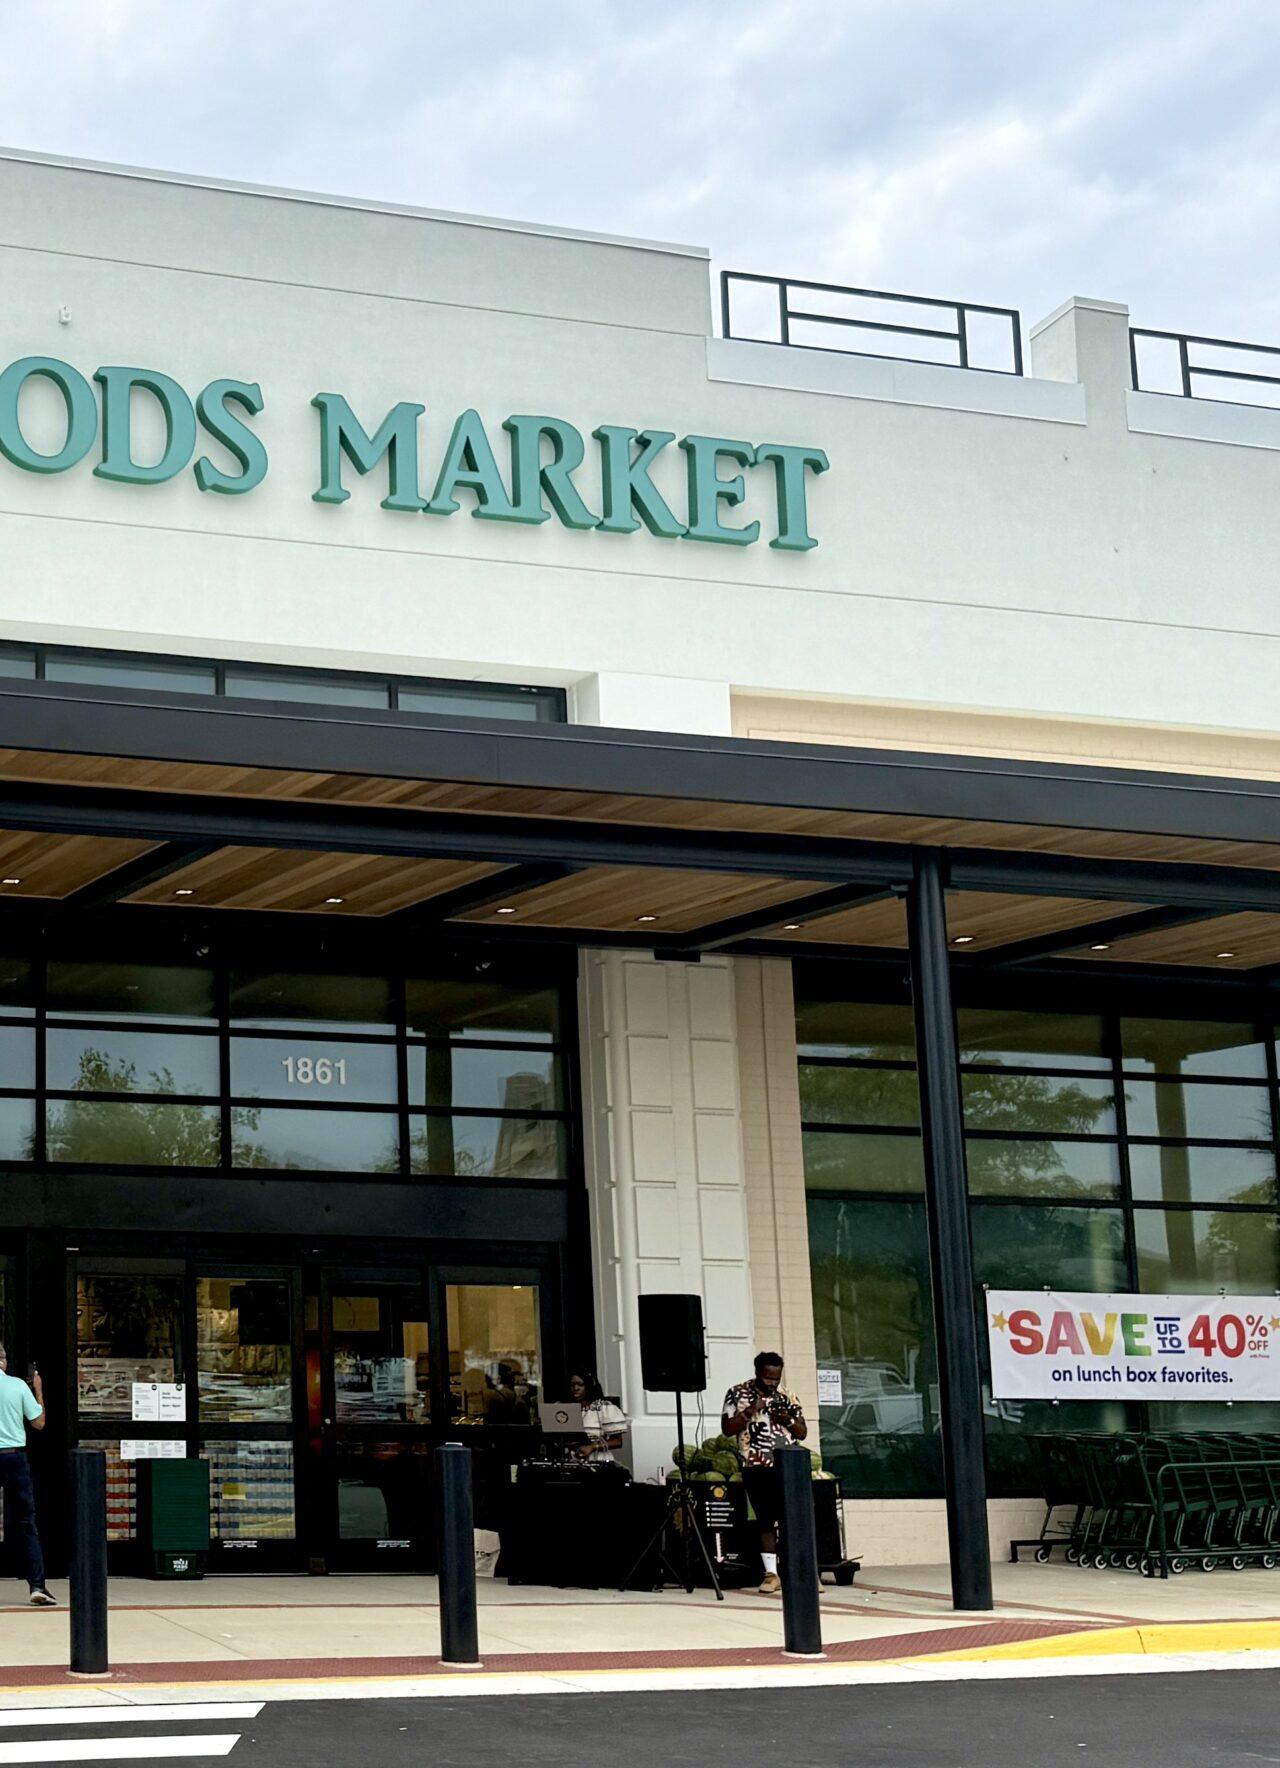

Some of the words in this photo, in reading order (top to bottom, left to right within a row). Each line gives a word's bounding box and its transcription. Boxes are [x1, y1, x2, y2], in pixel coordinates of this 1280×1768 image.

[312, 393, 828, 551] MARKET
[281, 1056, 346, 1085] 1861
[1008, 1310, 1152, 1357] SAVE
[1157, 1323, 1180, 1336] UP
[1159, 1337, 1182, 1349] TO
[1248, 1340, 1269, 1351] OFF
[1052, 1368, 1071, 1383] on
[1077, 1366, 1121, 1383] lunch
[1126, 1367, 1157, 1383] box
[1161, 1367, 1234, 1384] favorites.
